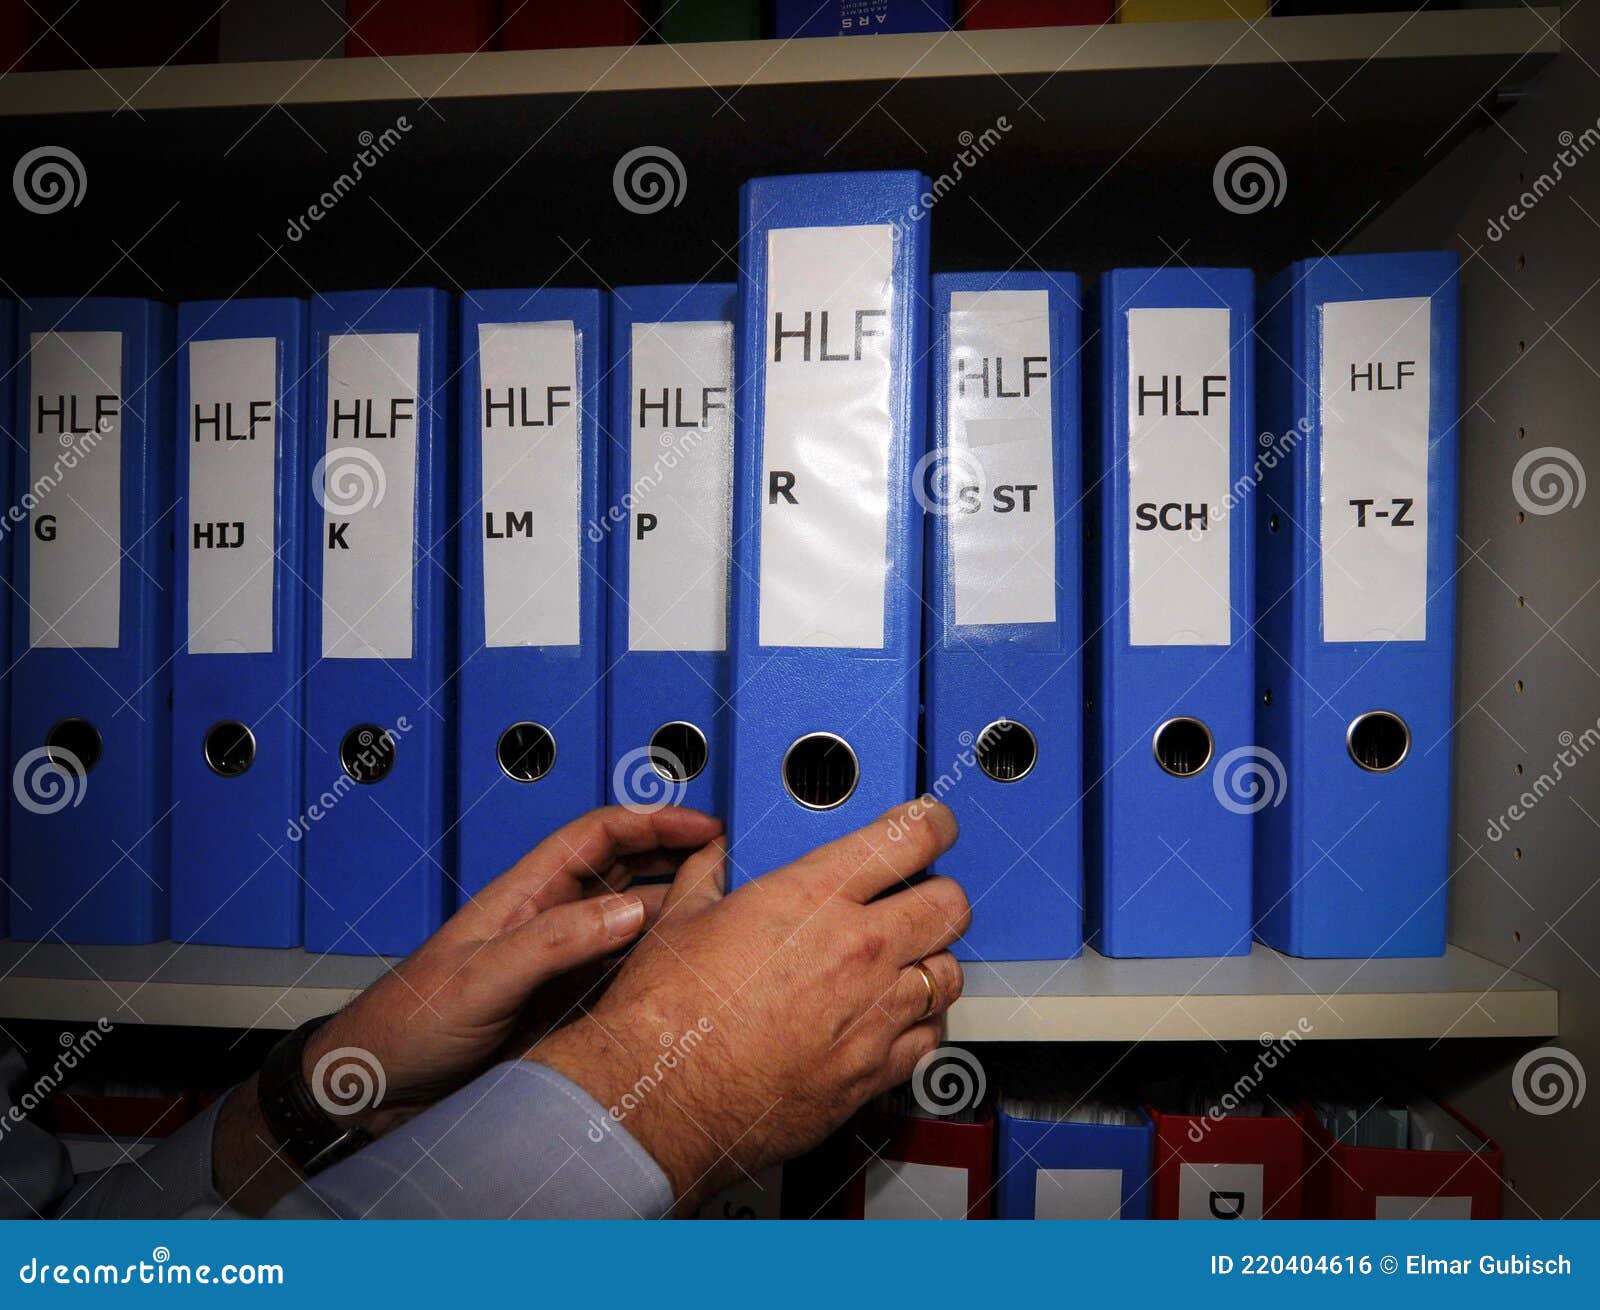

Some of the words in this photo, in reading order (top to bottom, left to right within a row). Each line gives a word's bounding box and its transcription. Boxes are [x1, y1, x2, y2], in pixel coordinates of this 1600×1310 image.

[841, 13, 887, 28] ARS
[773, 309, 887, 363] HLF
[957, 356, 1048, 399] HLF
[1350, 360, 1416, 392] HLF
[485, 385, 571, 428] HLF
[639, 386, 728, 428] HLF
[1138, 375, 1227, 416] HLF
[37, 394, 119, 434] HLF
[194, 400, 272, 442] HLF
[332, 398, 414, 439] HLF
[769, 471, 799, 506] R
[959, 485, 982, 515] S
[993, 484, 1038, 514] ST
[34, 514, 57, 542] G
[485, 510, 533, 539] LM
[636, 513, 658, 540] P
[1135, 502, 1208, 532] SCH
[1349, 498, 1415, 528] T-Z
[193, 521, 245, 549] HIJ
[328, 522, 350, 550] K
